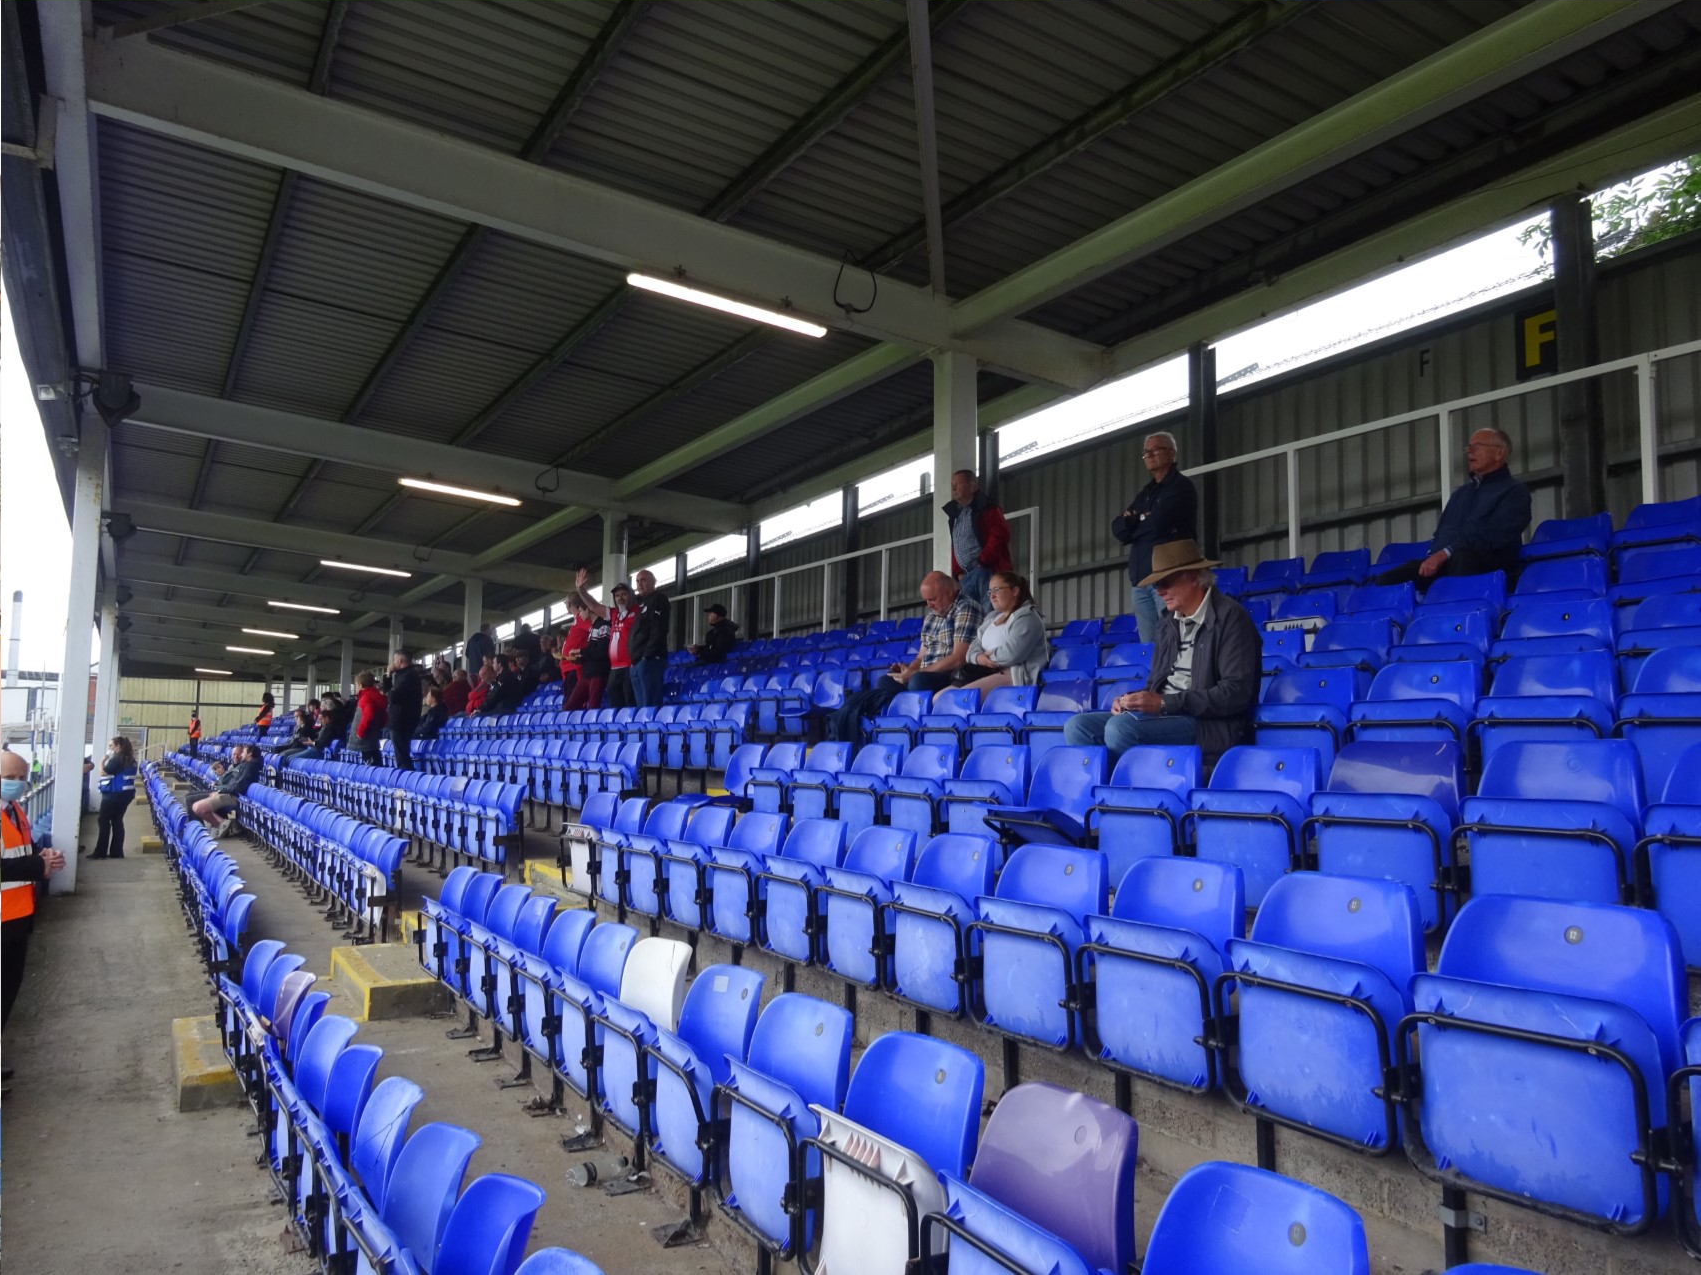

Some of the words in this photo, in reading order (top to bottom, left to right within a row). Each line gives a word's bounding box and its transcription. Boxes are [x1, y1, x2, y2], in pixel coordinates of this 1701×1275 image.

[1523, 309, 1556, 368] F
[1420, 348, 1430, 377] F
[1569, 930, 1578, 940] 12
